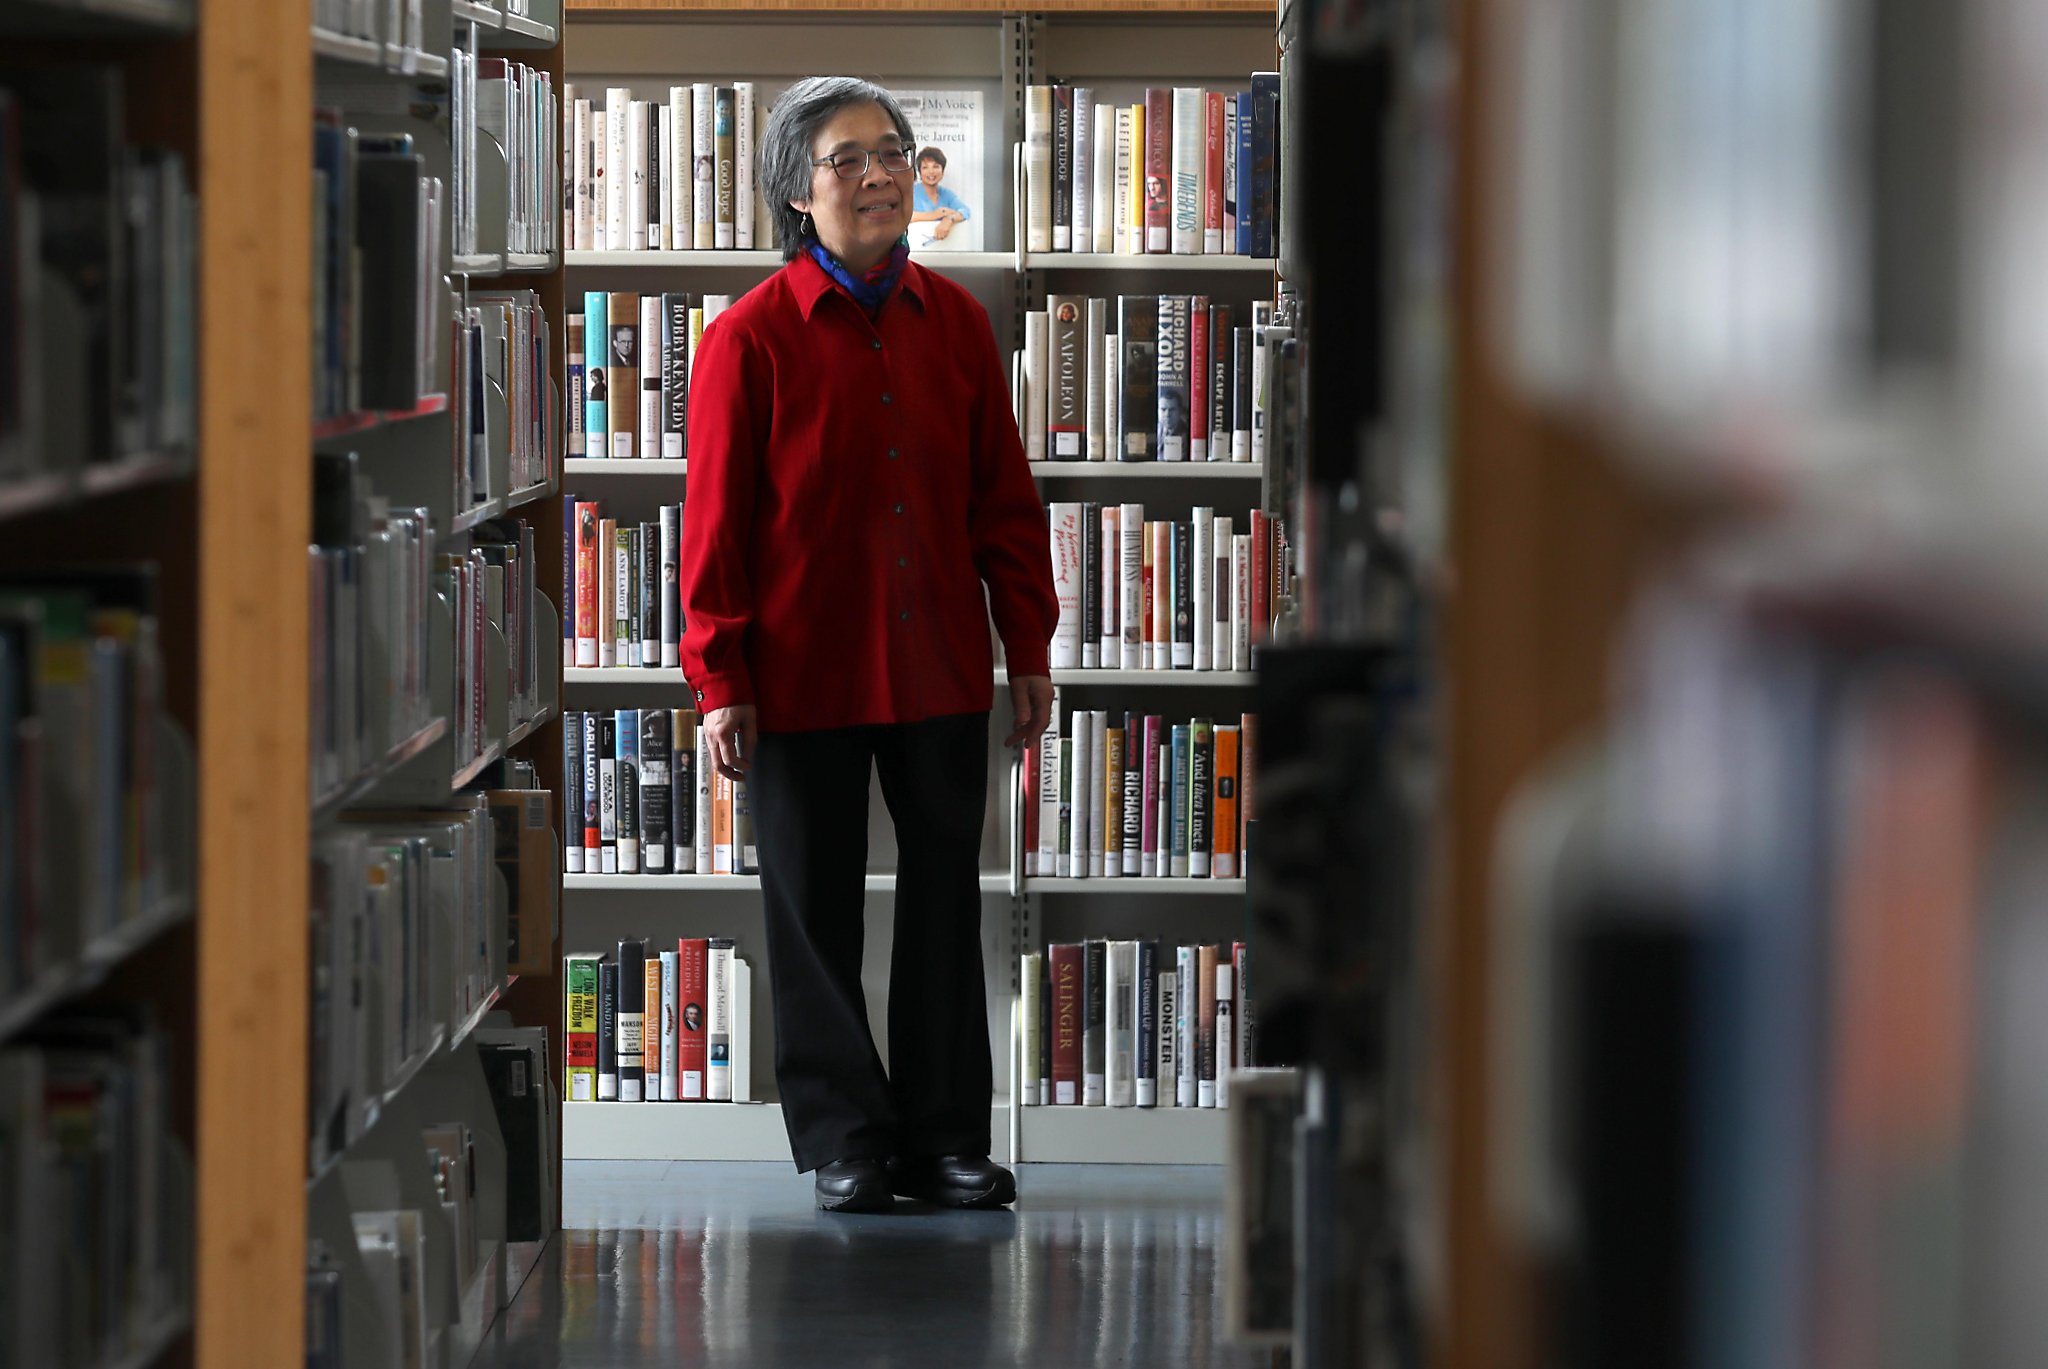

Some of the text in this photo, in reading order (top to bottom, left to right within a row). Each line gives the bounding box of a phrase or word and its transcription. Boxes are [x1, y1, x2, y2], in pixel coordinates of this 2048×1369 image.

[928, 99, 975, 111] My Voice
[932, 131, 965, 142] Jarrett
[1058, 108, 1068, 181] MARY TUDOR
[1153, 102, 1163, 168] MAGNIFICO
[717, 159, 732, 215] Good Pope
[1177, 171, 1197, 232] TIMEBENDS
[1158, 300, 1173, 371] NIXON
[1173, 300, 1185, 371] RICHARD
[663, 342, 671, 393] LARRY TYE
[672, 304, 685, 430] BOBBY KENNEDY
[1060, 329, 1074, 420] NAPOLEON
[1215, 363, 1224, 432] ESCAPE ARTIS
[567, 716, 577, 757] LINCOLN
[586, 717, 595, 792] CARLI LLOYD
[623, 730, 634, 761] LIES
[1043, 730, 1058, 803] Radziwill
[1111, 738, 1120, 793] LADY RED
[1124, 771, 1140, 833] RICHARD
[1194, 783, 1206, 808] then
[647, 966, 659, 991] WEST
[716, 953, 726, 1031] Thurgood Marshall
[1090, 949, 1102, 983] James
[572, 986, 582, 1028] TO FREEDOM
[583, 978, 594, 1018] LONG WALK
[604, 993, 612, 1038] MANDELA
[1059, 963, 1073, 1049] SALINGER
[1143, 978, 1153, 1015] Ground
[647, 1017, 658, 1046] NIGHT
[1161, 991, 1173, 1064] MONSTER
